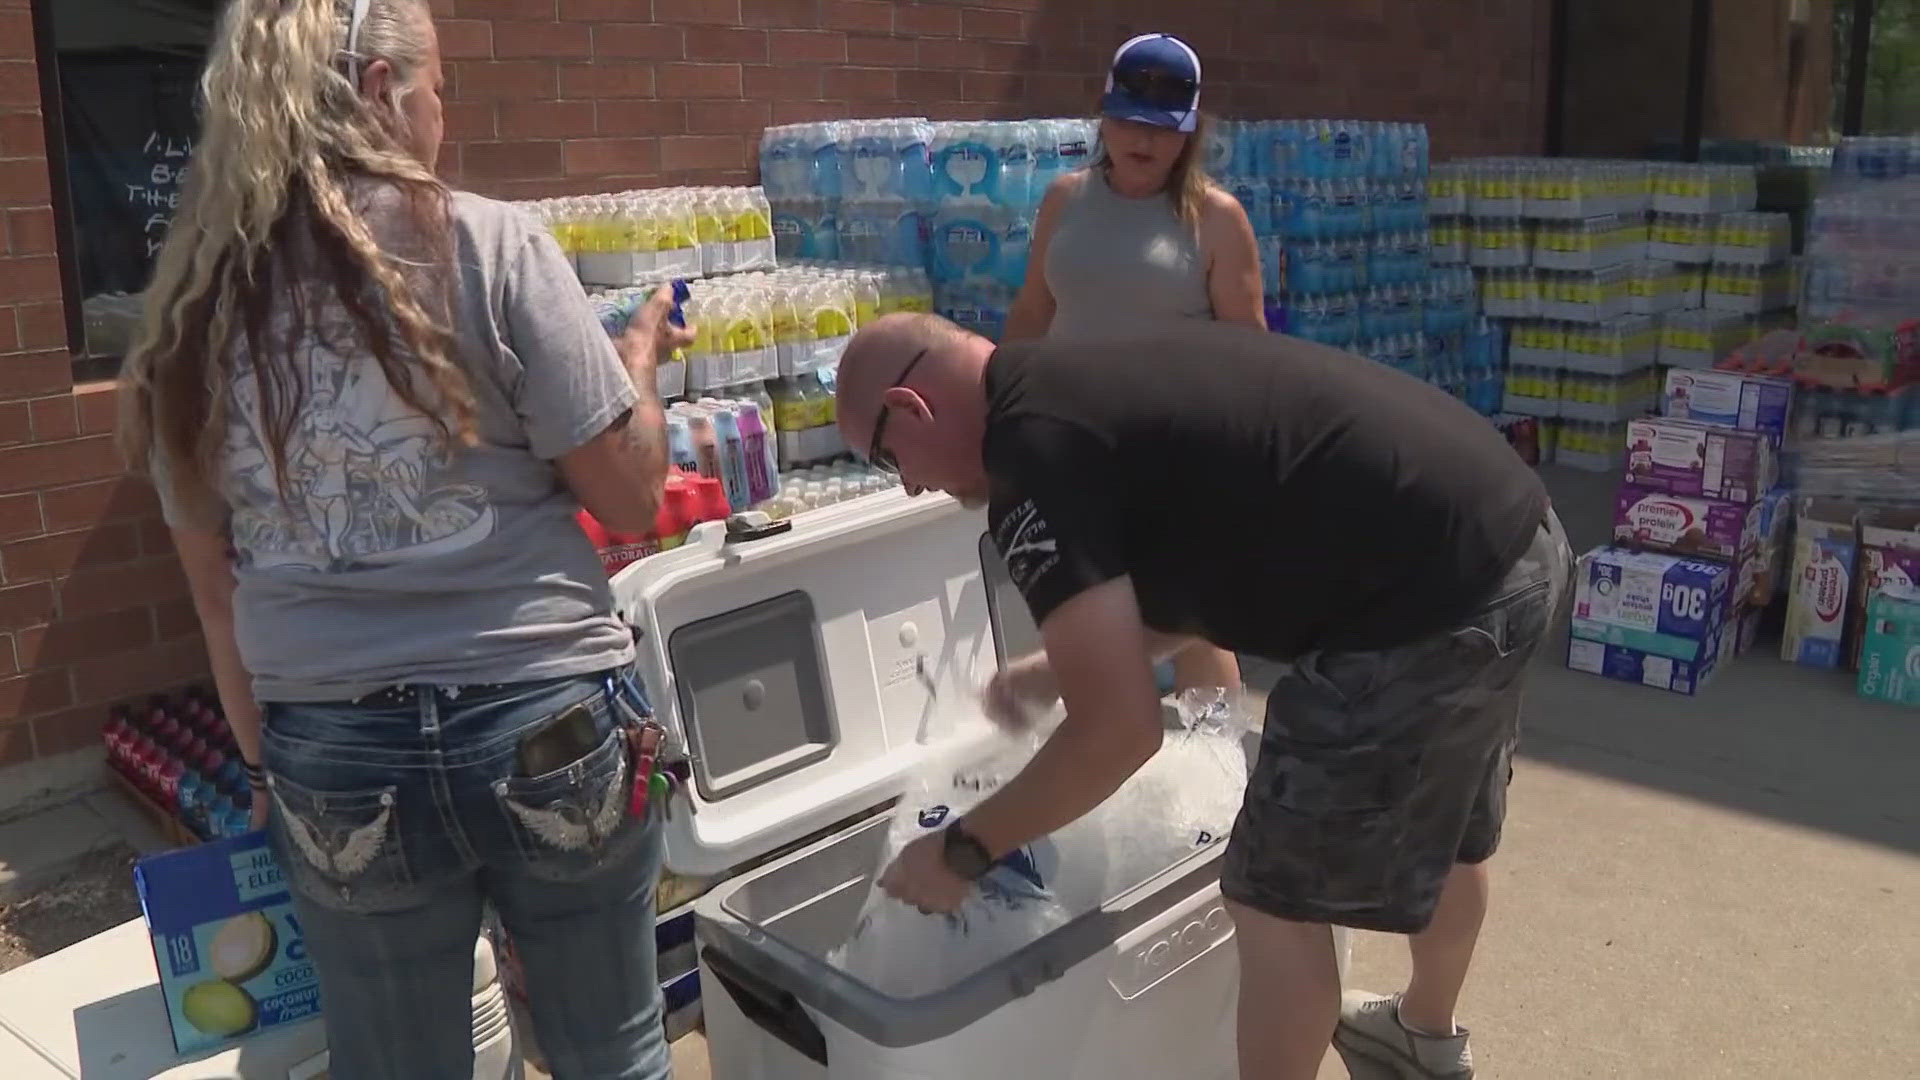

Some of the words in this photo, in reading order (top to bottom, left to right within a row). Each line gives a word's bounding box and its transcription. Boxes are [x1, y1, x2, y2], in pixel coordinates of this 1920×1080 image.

[1638, 503, 1680, 517] premier
[1639, 517, 1675, 530] protein
[1863, 653, 1881, 694] Orgain
[170, 936, 192, 968] 18
